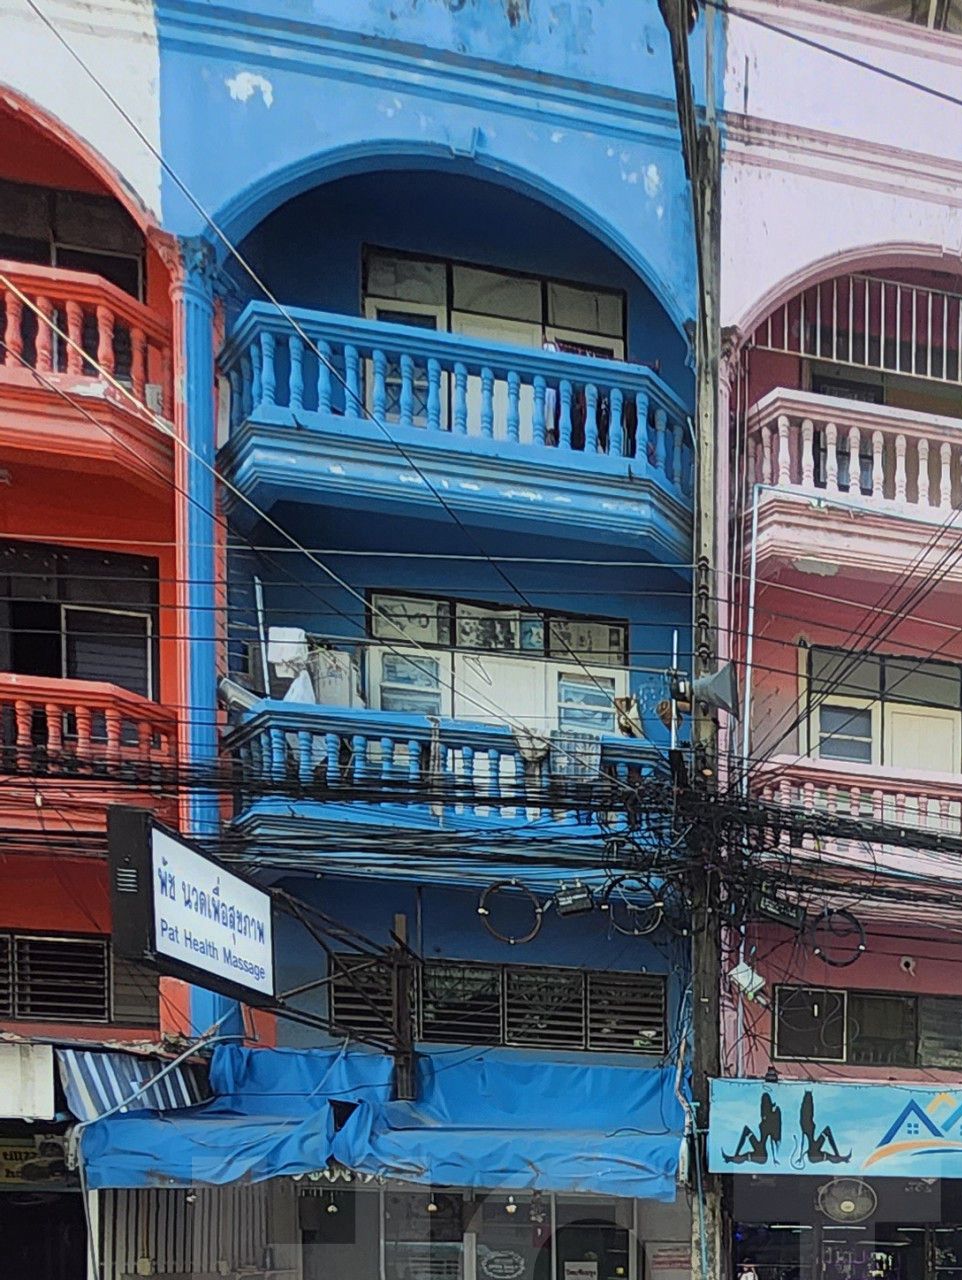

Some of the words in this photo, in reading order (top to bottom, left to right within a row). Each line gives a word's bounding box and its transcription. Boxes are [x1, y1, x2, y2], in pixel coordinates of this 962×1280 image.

[182, 877, 265, 945] นวดเพื่อสุขภาพ
[160, 919, 179, 944] Pat
[184, 929, 219, 960] Health
[223, 947, 265, 981] Massage
